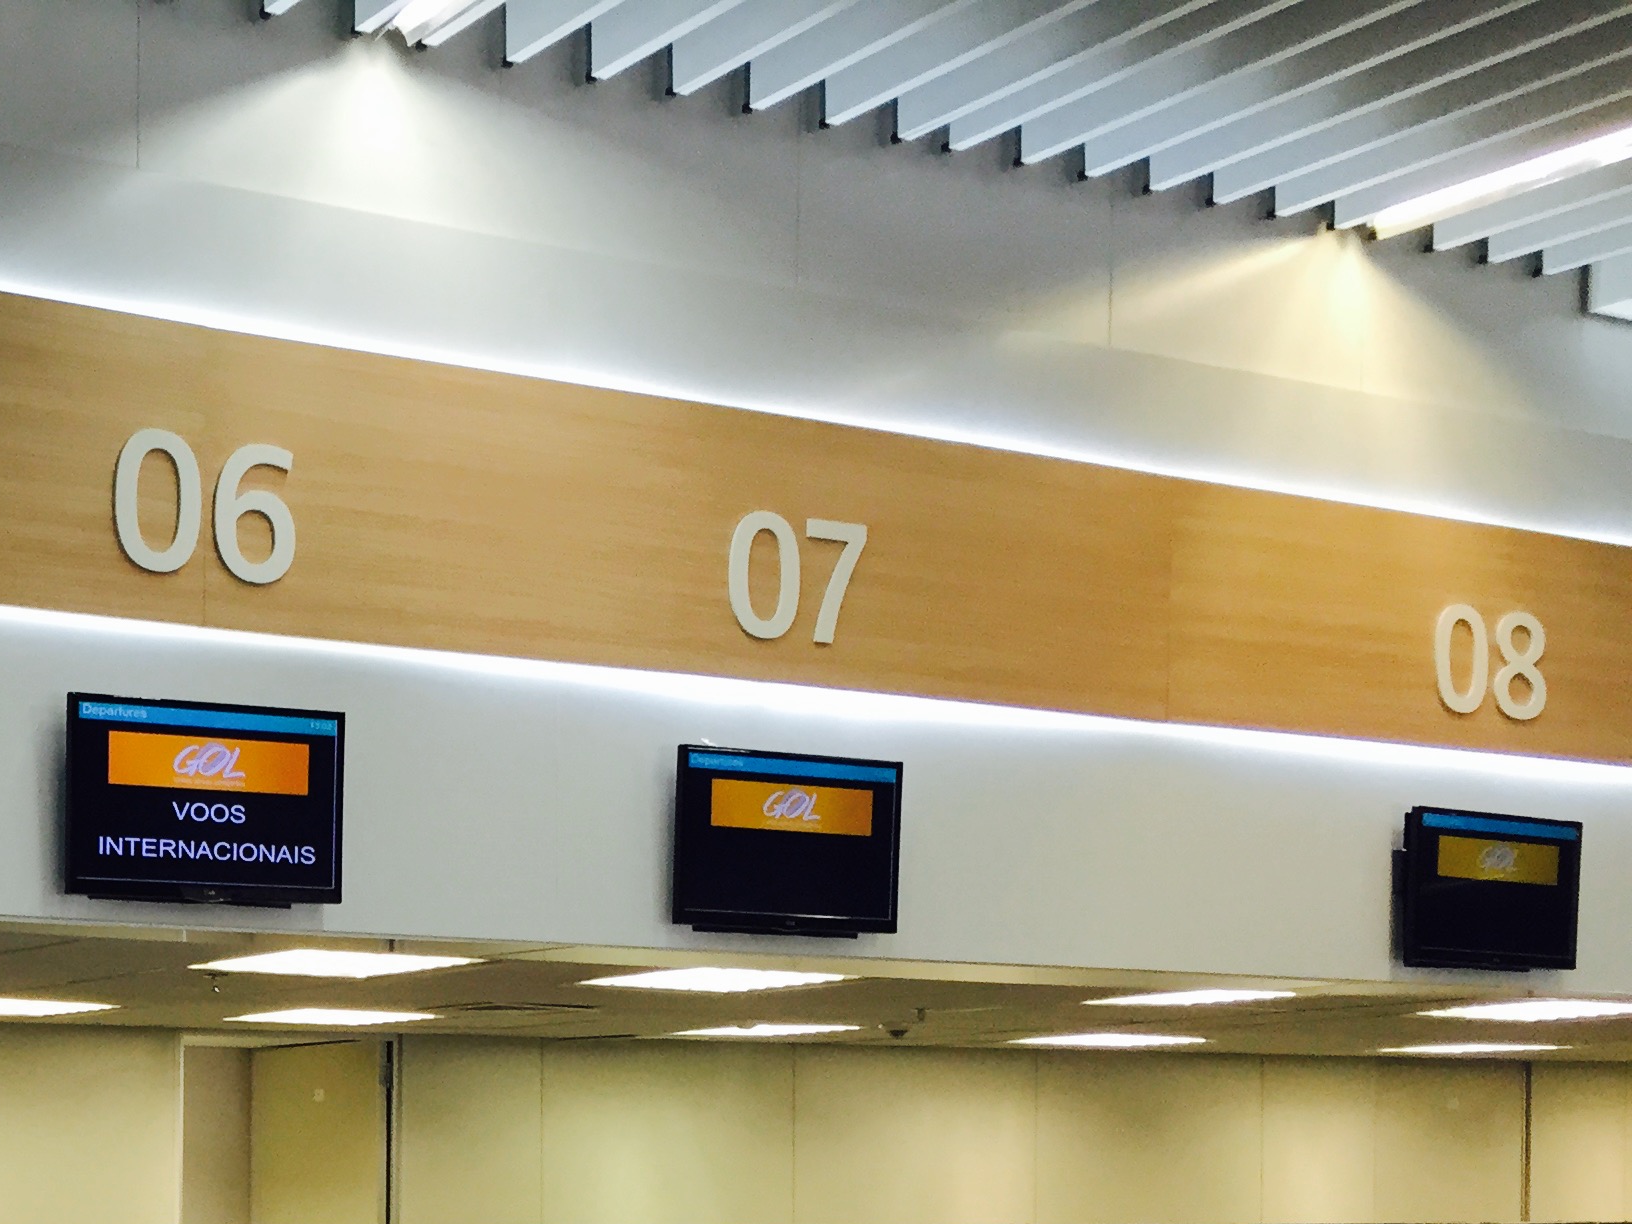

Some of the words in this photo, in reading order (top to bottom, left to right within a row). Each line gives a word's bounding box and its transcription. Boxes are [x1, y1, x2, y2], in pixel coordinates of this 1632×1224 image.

[114, 427, 297, 585] 06
[727, 509, 868, 645] 07
[1433, 603, 1548, 721] 08
[82, 702, 148, 719] Departures
[172, 742, 246, 780] GOL
[172, 801, 246, 824] VOOS
[762, 788, 822, 821] GOL
[98, 836, 317, 865] INTERNACIONAIS
